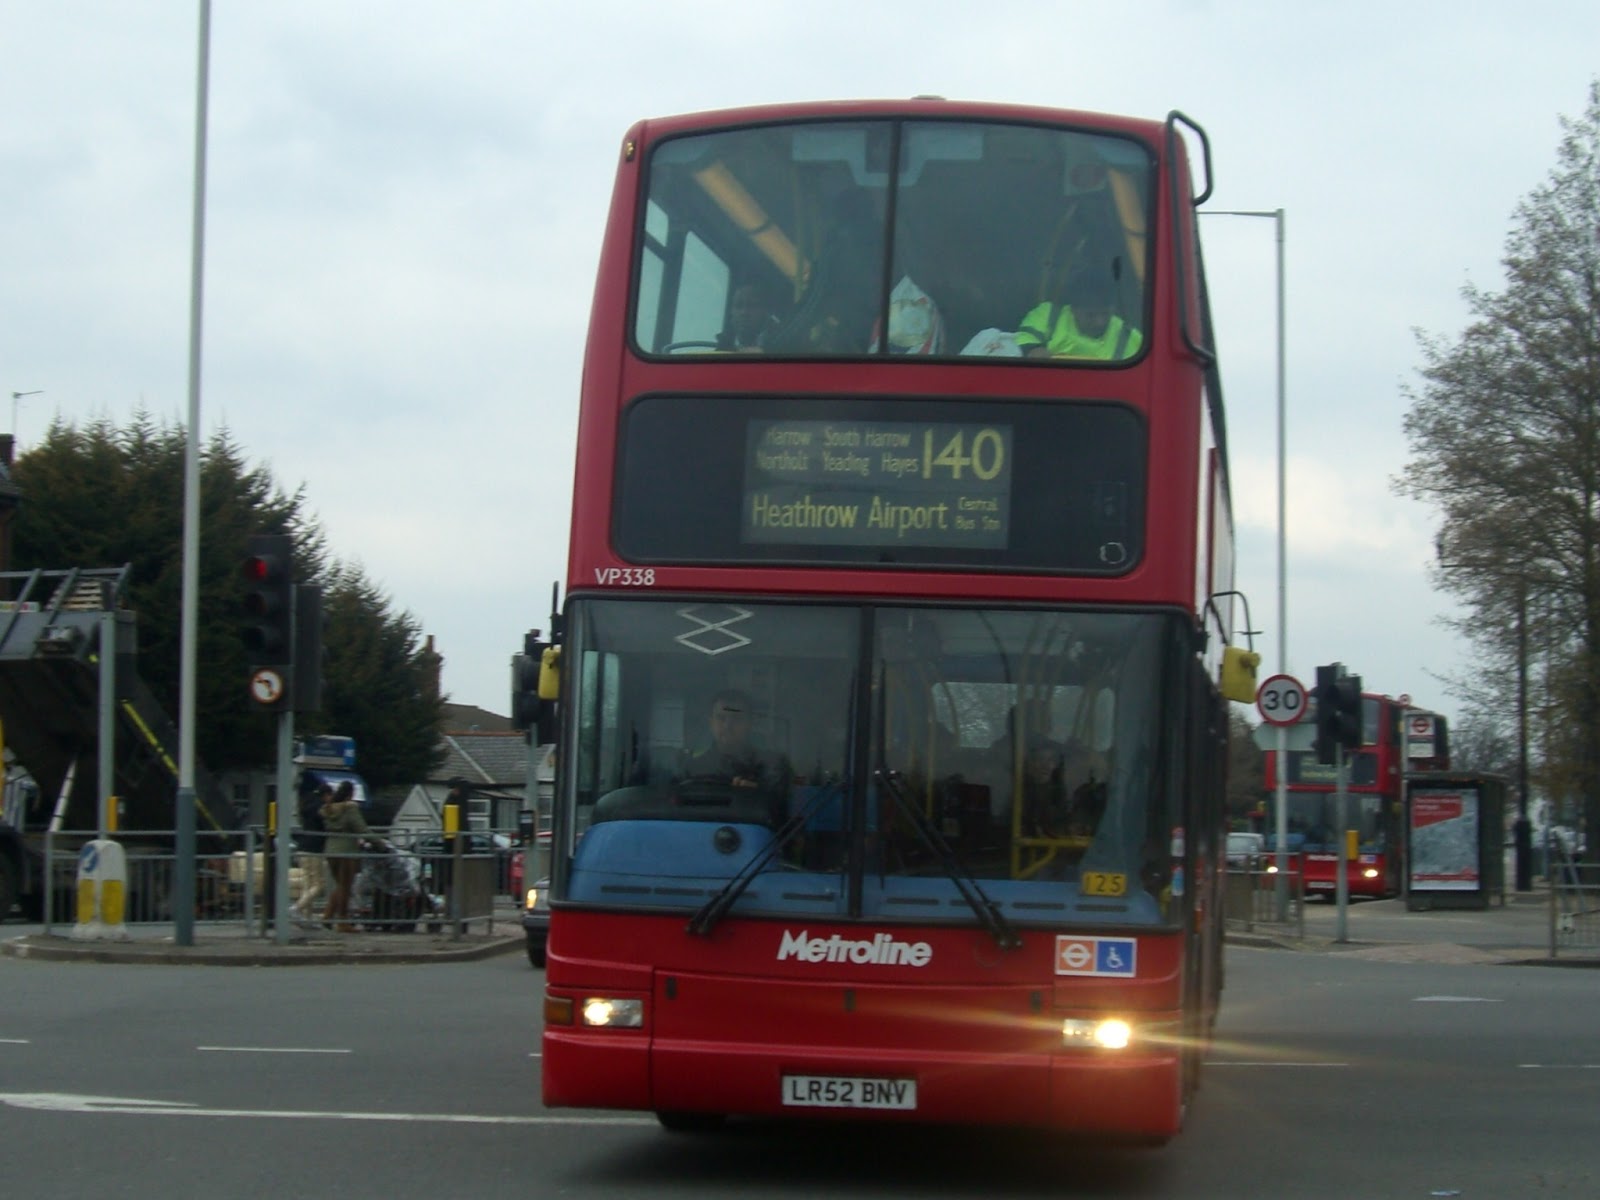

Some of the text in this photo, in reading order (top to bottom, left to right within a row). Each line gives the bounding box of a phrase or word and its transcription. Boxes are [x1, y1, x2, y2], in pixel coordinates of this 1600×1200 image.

[823, 425, 861, 446] South
[865, 428, 911, 447] Harrow
[881, 452, 919, 478] Hayes
[922, 428, 1004, 481] 140
[752, 494, 949, 537] Heathrow Airport
[594, 567, 656, 586] VP338
[1264, 690, 1300, 710] 30
[1085, 874, 1122, 893] 125
[776, 929, 933, 967] Metroline
[791, 1080, 907, 1104] LR52 BNV
